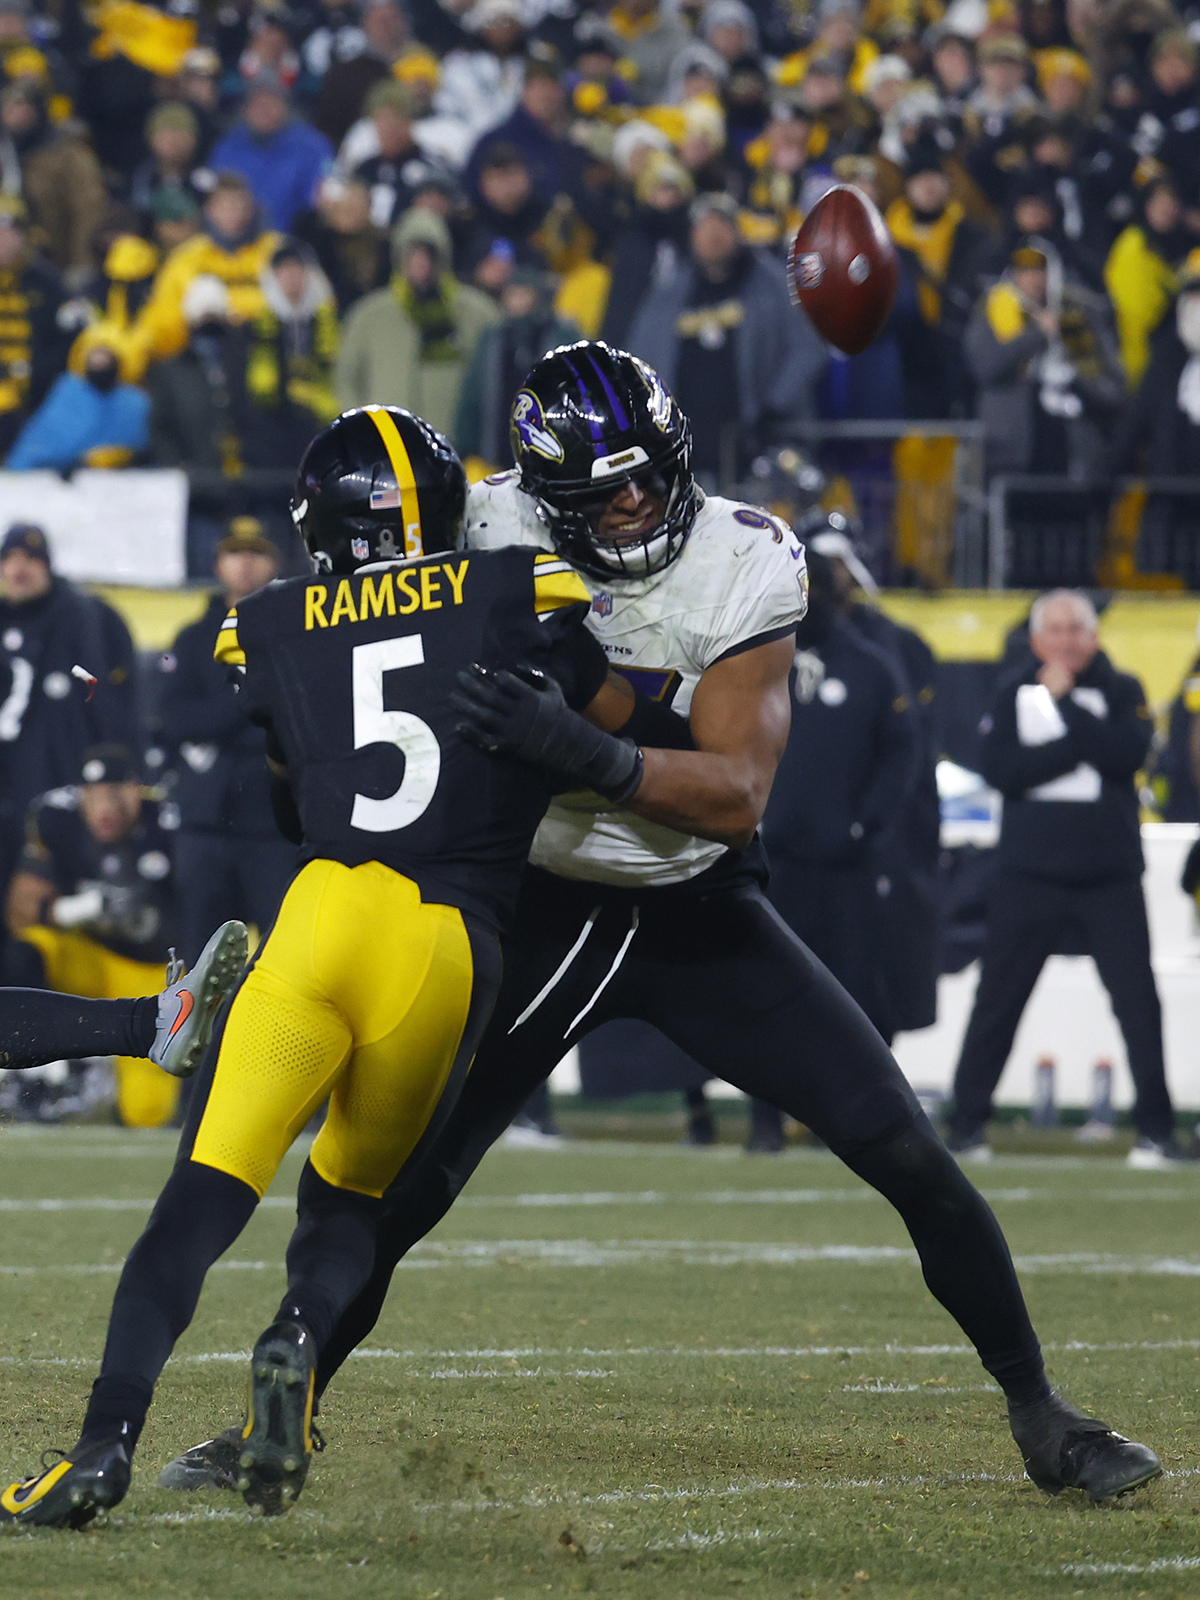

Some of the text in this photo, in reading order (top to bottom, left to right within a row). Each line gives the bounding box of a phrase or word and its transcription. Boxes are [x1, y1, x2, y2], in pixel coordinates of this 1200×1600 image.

[406, 522, 423, 558] 5
[732, 501, 791, 544] 9
[304, 559, 471, 632] RAMSEY
[601, 643, 633, 655] ENS
[350, 633, 441, 832] 5
